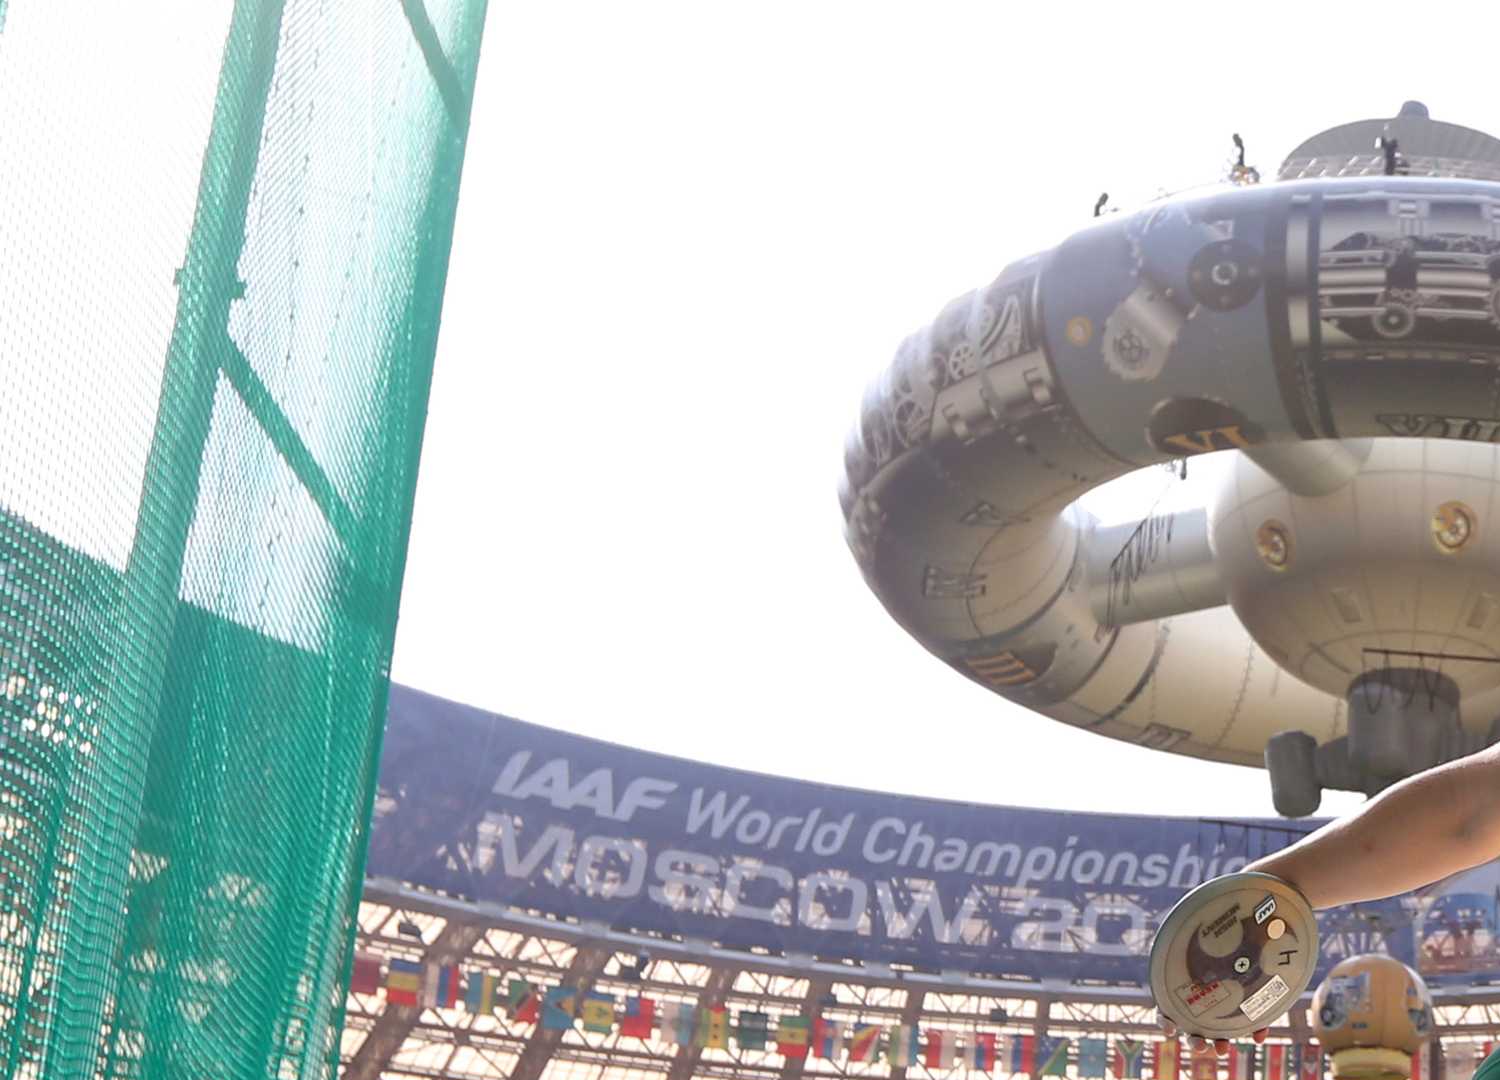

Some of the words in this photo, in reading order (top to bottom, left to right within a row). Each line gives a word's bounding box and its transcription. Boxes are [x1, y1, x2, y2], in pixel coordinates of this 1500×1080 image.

[491, 750, 679, 822] IAAF
[685, 787, 856, 857] World
[474, 811, 984, 946] MOSCOW
